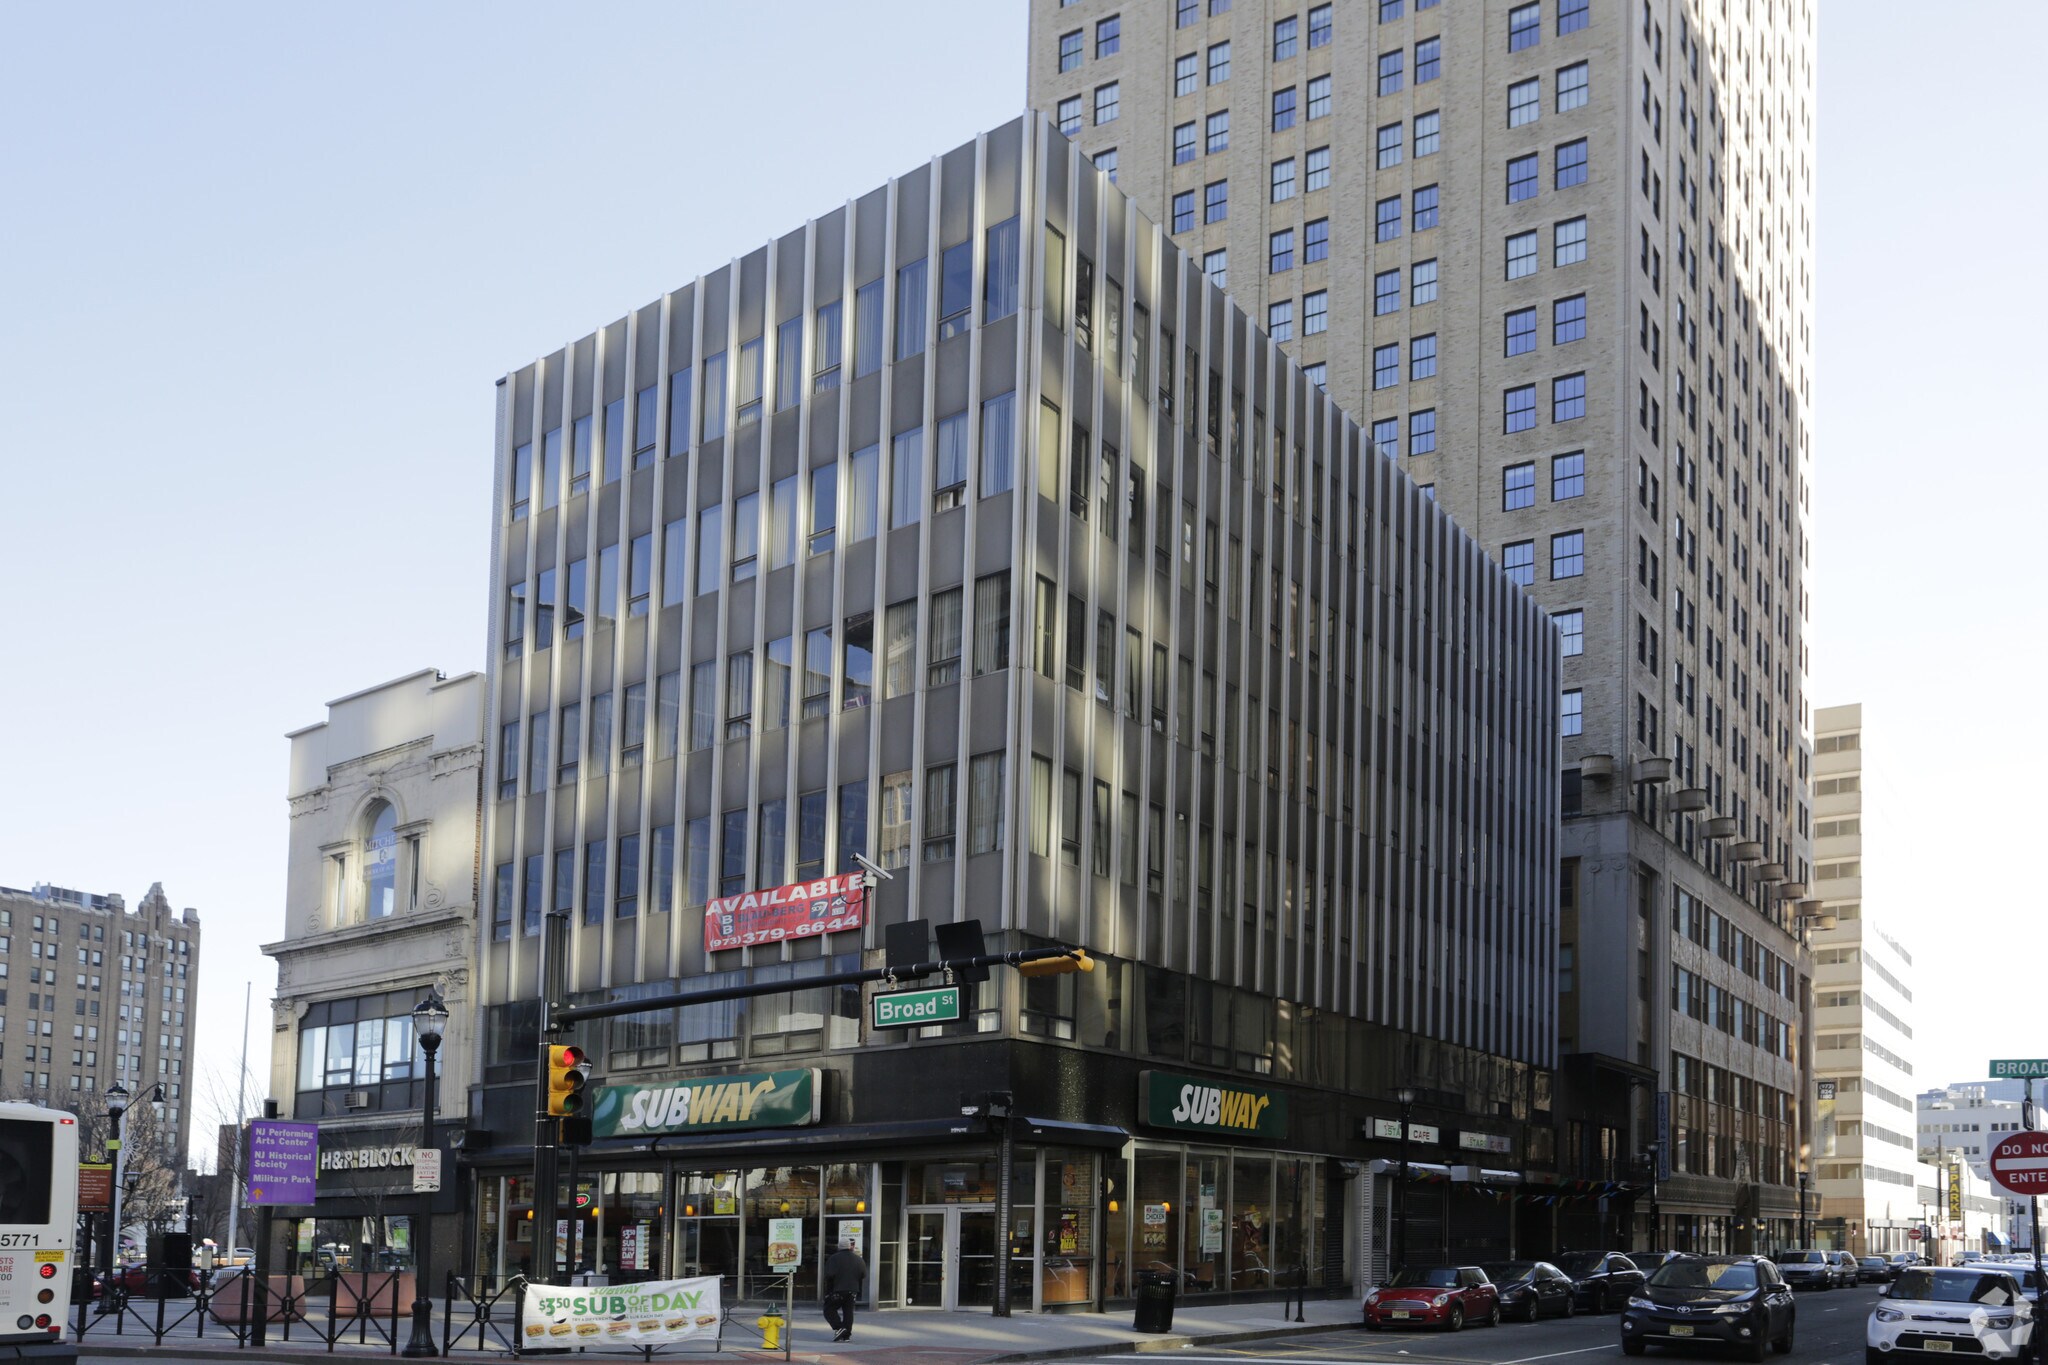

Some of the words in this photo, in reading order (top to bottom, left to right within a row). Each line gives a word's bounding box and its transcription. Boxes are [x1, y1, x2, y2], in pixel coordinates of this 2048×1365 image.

[706, 874, 863, 916] AVAILABLE
[710, 935, 741, 949] (973)
[742, 915, 860, 944] 379-6644
[880, 997, 936, 1019] Broad
[942, 995, 953, 1005] St
[1996, 1061, 2048, 1075] BROAD
[620, 1075, 776, 1131] SUBWAY
[1172, 1083, 1270, 1129] SUBWAY
[255, 1128, 266, 1136] NJ
[269, 1128, 314, 1139] Performing
[256, 1137, 275, 1145] Arts
[278, 1138, 309, 1146] Center
[254, 1151, 265, 1159] NJ
[269, 1152, 312, 1160] Historical
[2002, 1144, 2021, 1155] DO
[2031, 1143, 2048, 1154] NO
[254, 1160, 287, 1169] Society
[321, 1150, 354, 1170] H&R
[358, 1146, 415, 1168] BLOCK
[253, 1174, 288, 1184] Military
[291, 1175, 311, 1183] Park
[2009, 1171, 2048, 1184] ENTE
[1949, 1173, 1960, 1212] PARK
[0, 1234, 39, 1246] 5771
[589, 1285, 645, 1296] SUBWAY
[573, 1296, 627, 1315] SUB
[628, 1295, 650, 1306] OF
[652, 1290, 704, 1312] DAY
[628, 1305, 649, 1313] THE
